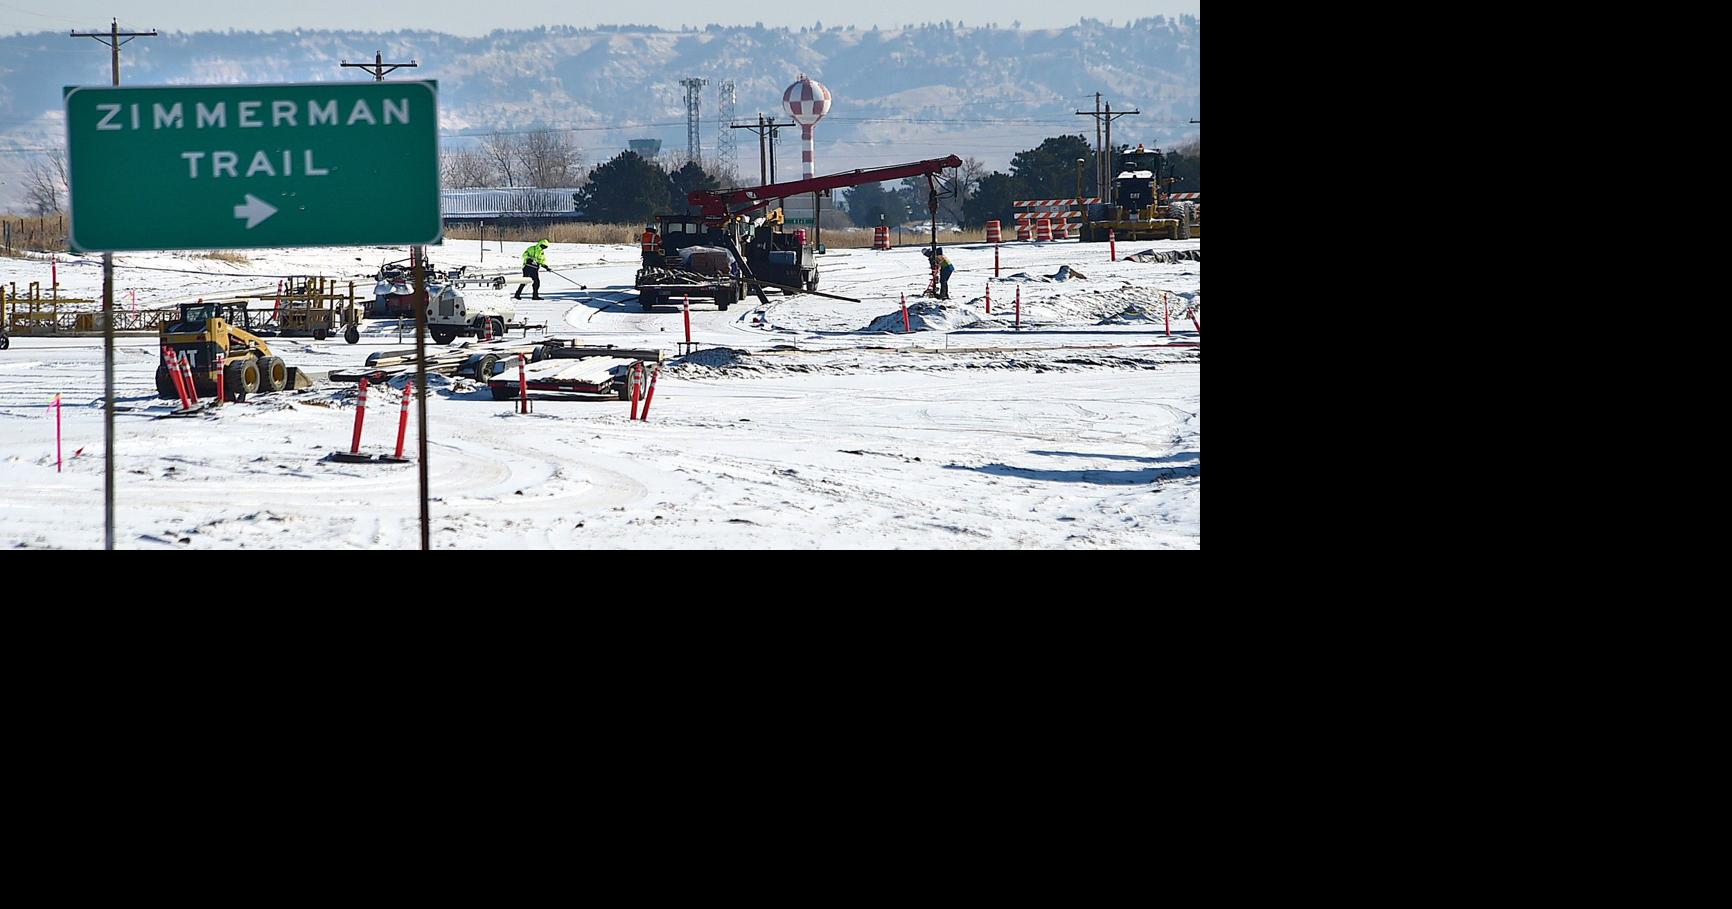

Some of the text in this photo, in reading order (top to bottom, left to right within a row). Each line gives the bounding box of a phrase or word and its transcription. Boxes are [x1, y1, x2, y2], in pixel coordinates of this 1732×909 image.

[96, 98, 410, 131] ZIMMERMAN
[181, 149, 329, 178] TRAIL
[177, 350, 198, 368] AT
